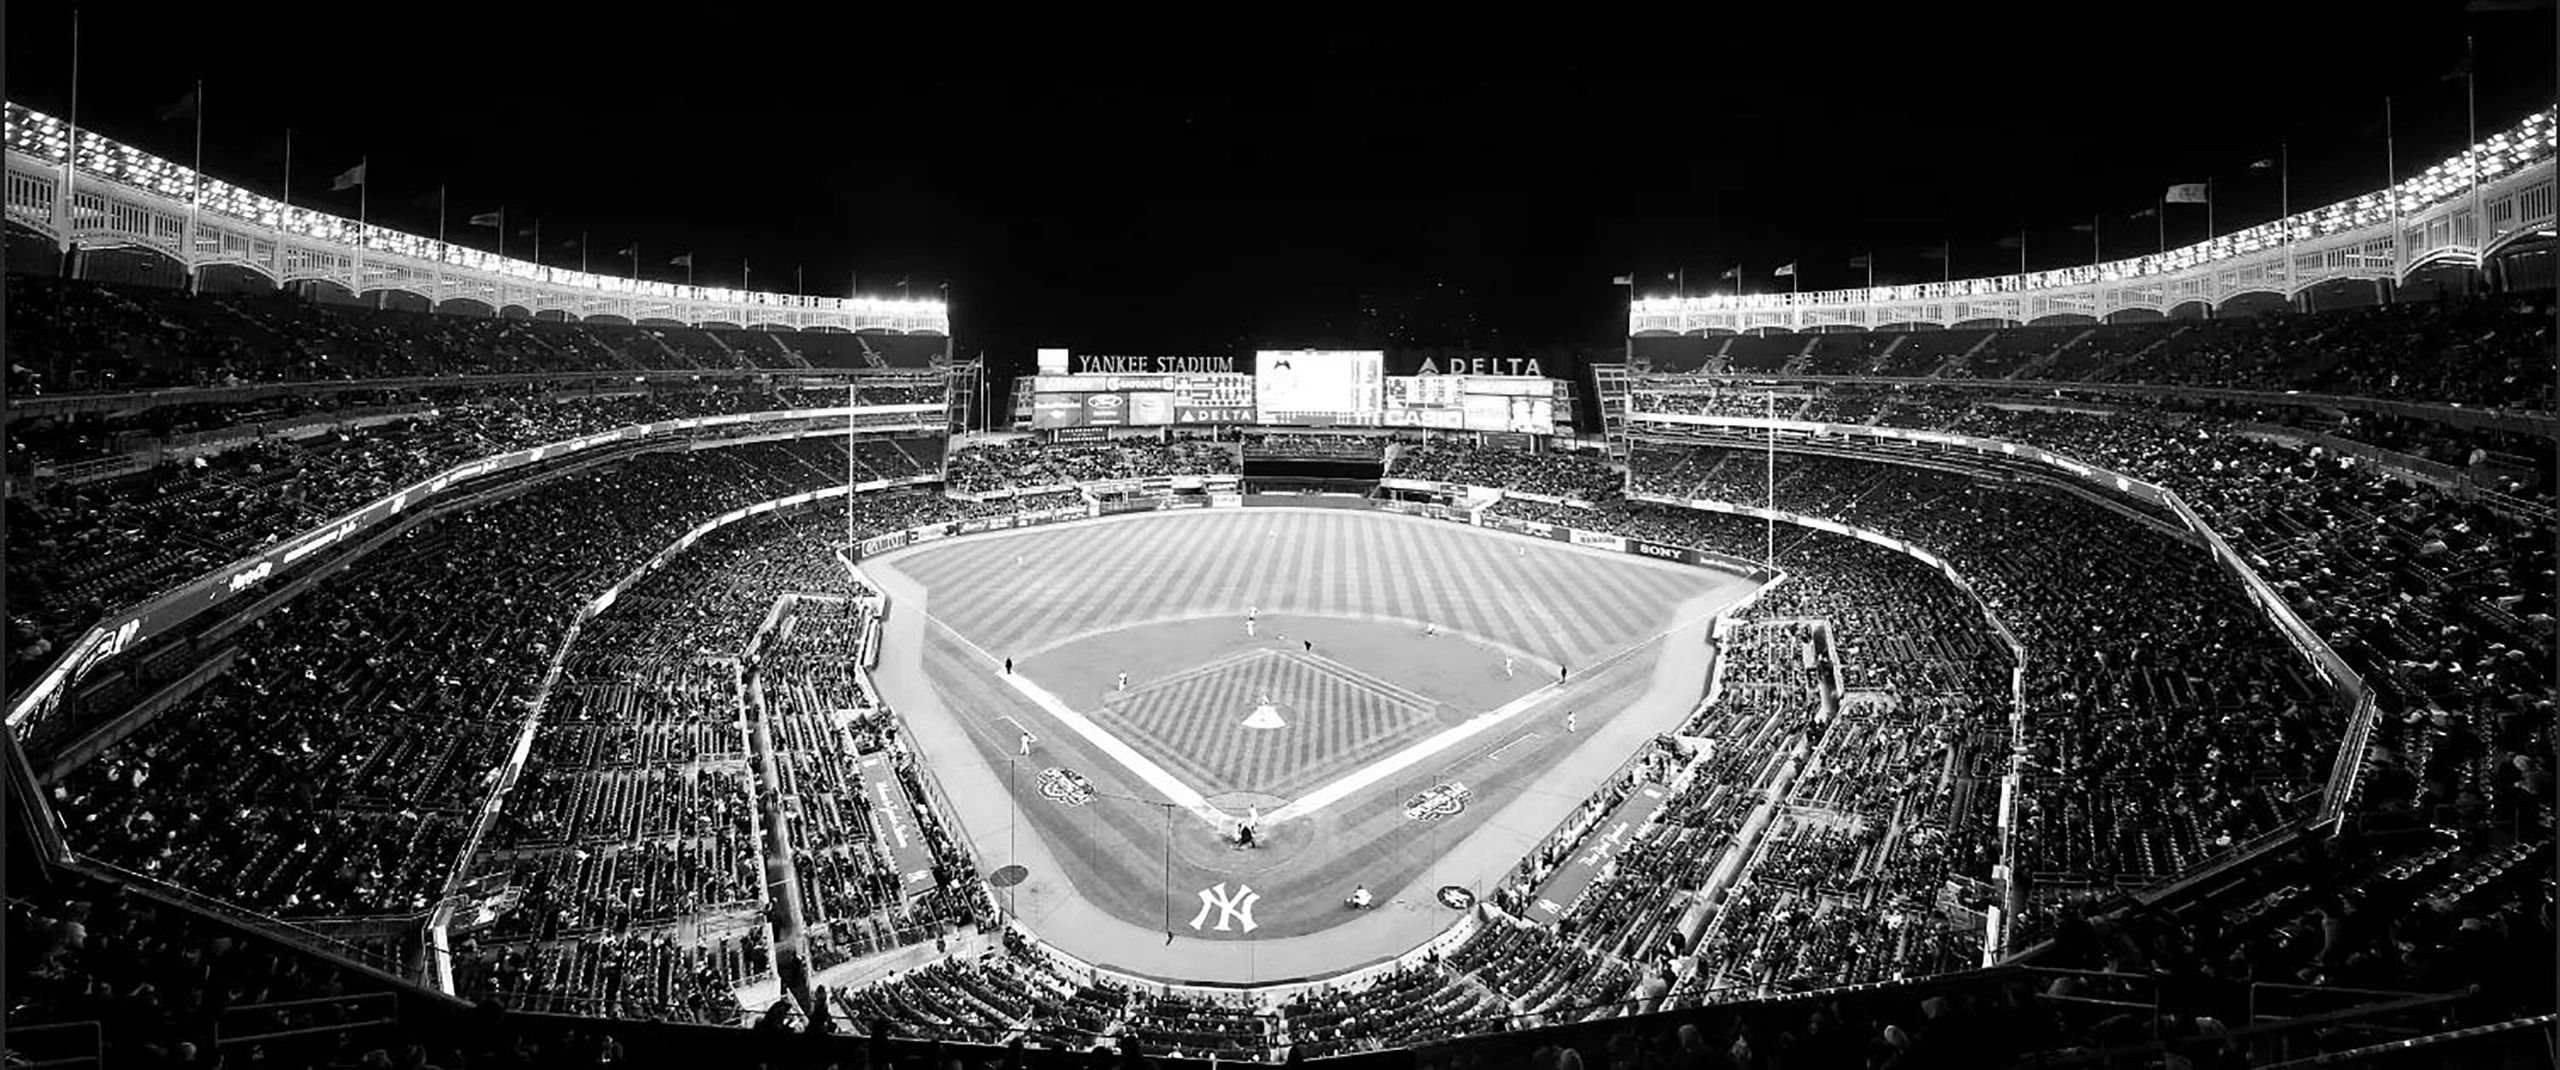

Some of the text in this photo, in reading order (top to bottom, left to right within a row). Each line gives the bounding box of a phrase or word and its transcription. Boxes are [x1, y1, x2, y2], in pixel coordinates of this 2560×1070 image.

[1079, 355, 1233, 373] YANKEE STADIUM
[1450, 357, 1541, 375] DELTA
[1198, 410, 1251, 422] DELTA
[1386, 411, 1462, 427] CASIO
[864, 535, 906, 554] Canon
[1640, 543, 1682, 559] SONY
[1189, 881, 1261, 933] NY
